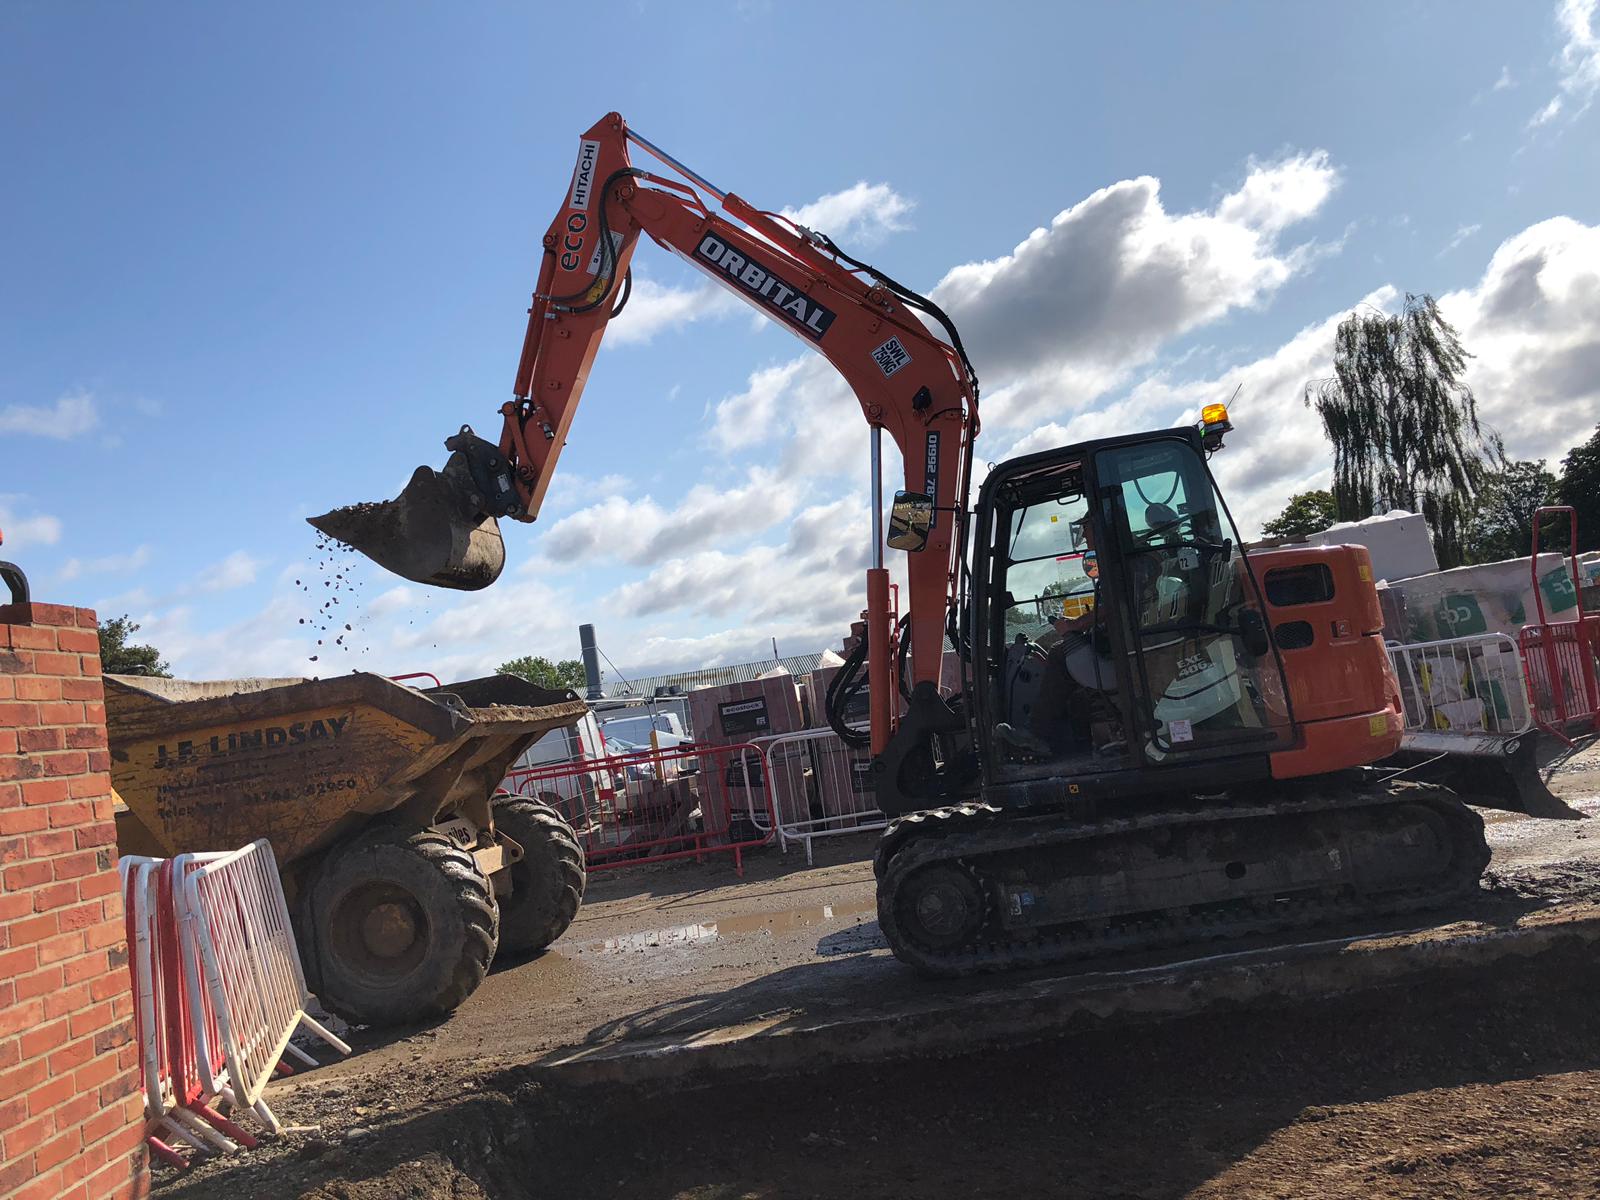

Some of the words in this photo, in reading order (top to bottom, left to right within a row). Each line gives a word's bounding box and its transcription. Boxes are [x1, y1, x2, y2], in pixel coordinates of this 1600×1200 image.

[573, 144, 596, 206] HITACHI
[699, 236, 824, 333] ORBITAL
[873, 346, 898, 374] 750KG
[885, 340, 906, 366] SWL
[927, 434, 938, 473] 01992
[209, 715, 351, 757] LINDSAY
